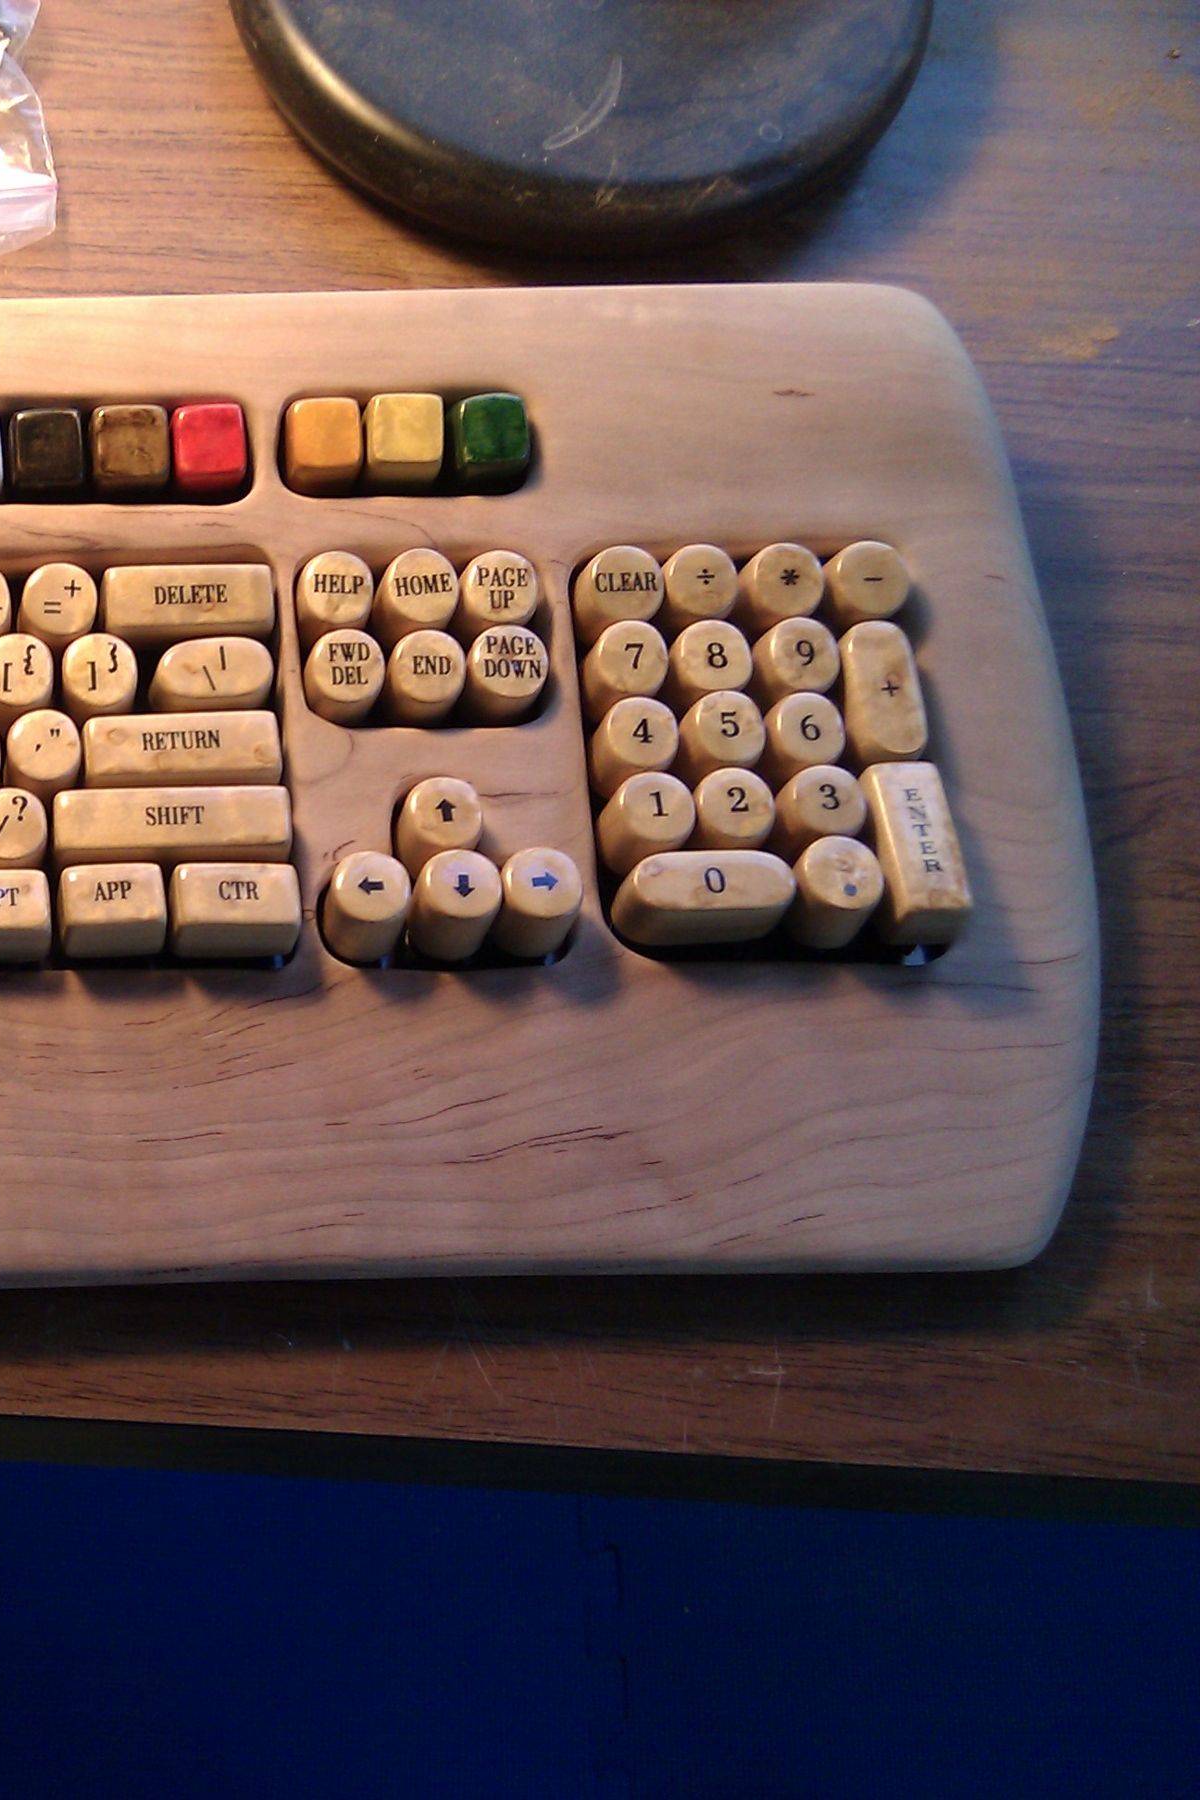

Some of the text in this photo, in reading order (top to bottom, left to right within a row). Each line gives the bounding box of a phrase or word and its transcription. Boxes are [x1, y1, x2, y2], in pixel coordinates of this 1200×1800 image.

[314, 574, 364, 594] HELP
[394, 573, 452, 597] HOME
[477, 567, 528, 588] PAGE
[595, 571, 659, 593] CLEAR
[154, 584, 228, 605] DELETE
[488, 590, 514, 609] UP
[328, 642, 370, 662] FWD
[486, 636, 536, 656] PAGE
[624, 643, 643, 669] 7
[708, 642, 728, 668] 8
[795, 640, 815, 666] 9
[332, 666, 368, 685] DEL
[412, 656, 451, 676] END
[484, 659, 542, 678] DOWN
[632, 718, 652, 743] 4
[720, 711, 739, 738] 5
[801, 714, 820, 741] 6
[142, 730, 220, 751] RETURN
[650, 791, 668, 817] 1
[727, 788, 749, 812] 2
[819, 784, 840, 810] 3
[145, 806, 204, 826] SHIFT
[904, 788, 943, 873] ENTER
[218, 880, 259, 901] CTR
[704, 868, 726, 893] 0
[94, 881, 132, 902] APP
